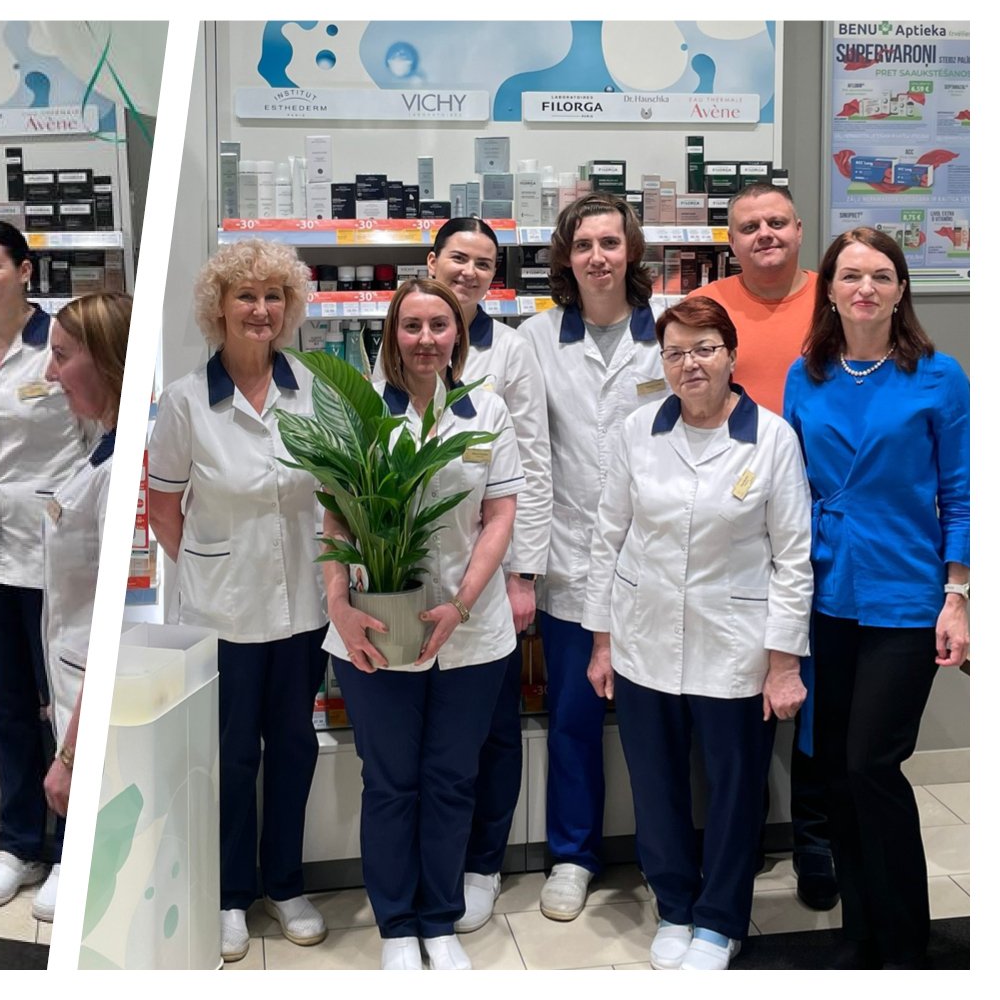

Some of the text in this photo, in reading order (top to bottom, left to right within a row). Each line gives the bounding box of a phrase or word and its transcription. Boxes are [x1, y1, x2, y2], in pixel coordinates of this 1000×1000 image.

[838, 23, 878, 35] BENU
[895, 24, 947, 38] Aptieka
[836, 43, 937, 68] SUPERVAROŅI
[875, 69, 897, 77] PRET
[273, 89, 318, 101] INSTITUT
[401, 93, 467, 112] VICHY
[541, 102, 603, 112] FILORGA
[264, 104, 328, 112] ESTHEDERM
[690, 103, 741, 119] Avène
[26, 114, 79, 132] Avène
[235, 220, 260, 230] -30%
[295, 220, 319, 230] -30%
[354, 220, 378, 230] -30%
[412, 220, 436, 230] -30%
[354, 292, 378, 302] -30%
